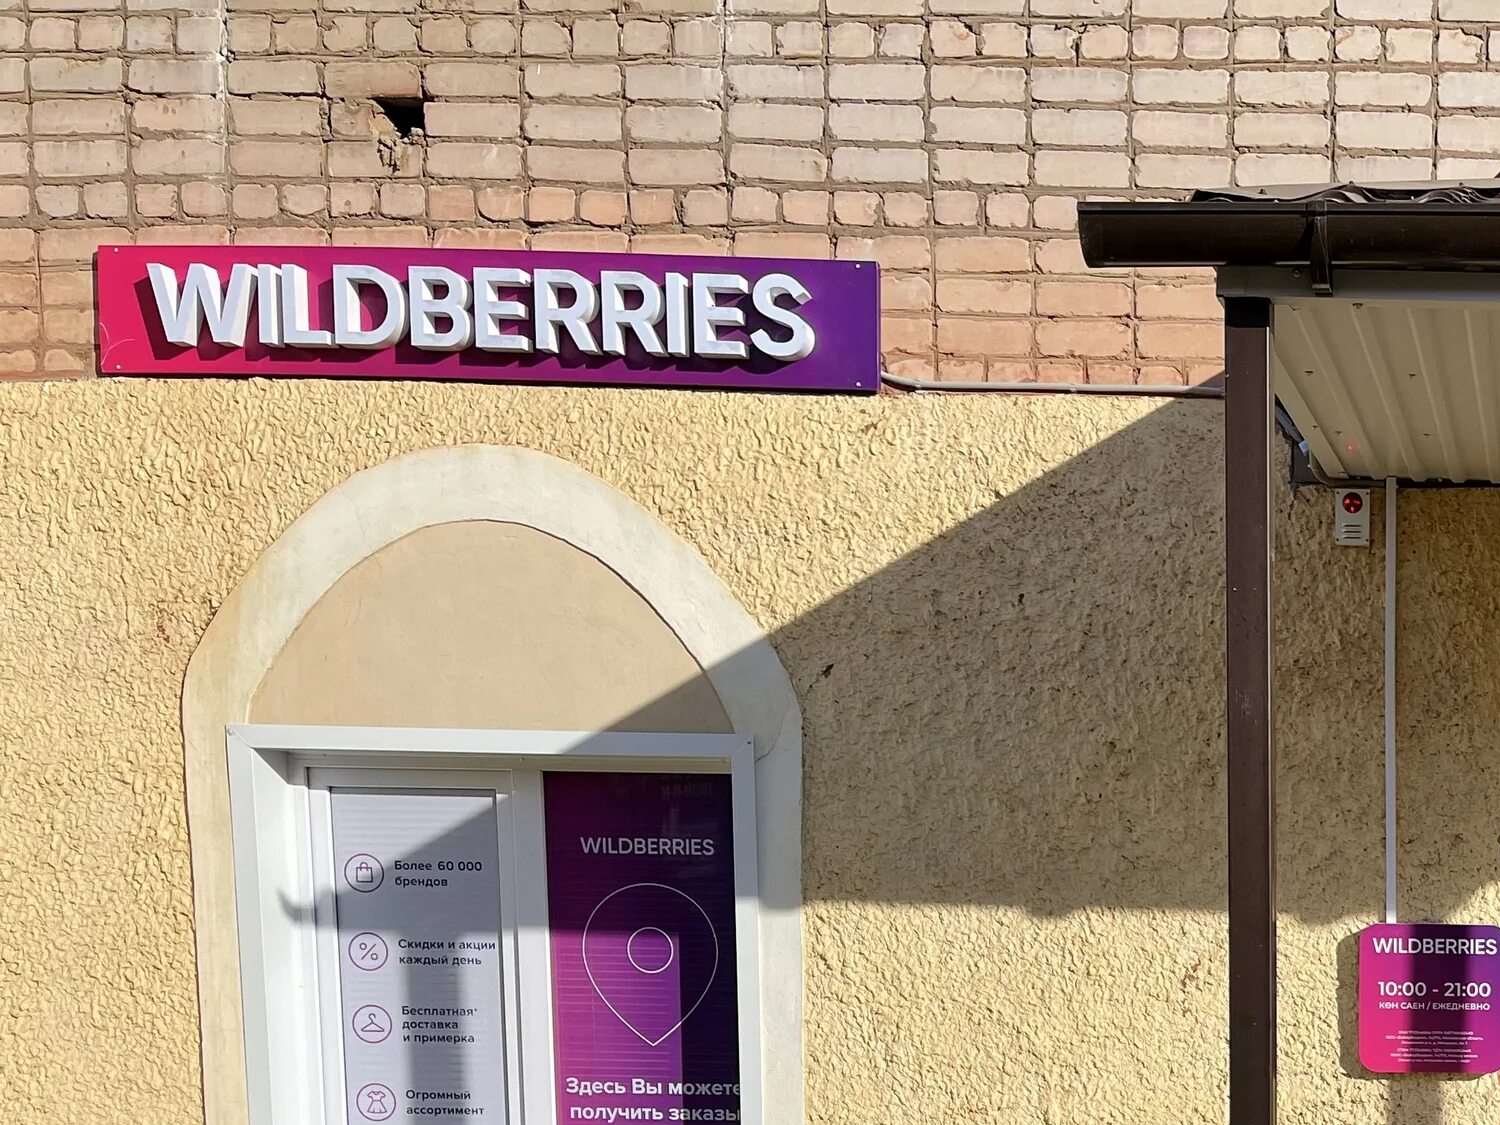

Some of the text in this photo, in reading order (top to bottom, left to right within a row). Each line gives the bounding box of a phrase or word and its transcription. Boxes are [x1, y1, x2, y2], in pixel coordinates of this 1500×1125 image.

[146, 262, 815, 361] WILDBERRIES
[580, 837, 715, 856] WILDBERRIES
[394, 860, 482, 872] Более 60 000
[394, 876, 448, 888] брендов
[398, 939, 496, 951] Скидки и акции
[1372, 937, 1498, 955] WILDBERRIES
[399, 955, 482, 966] каждый день
[1378, 981, 1427, 997] 10:00
[1444, 982, 1491, 998] 21:00
[1400, 1002, 1425, 1010] САЕН
[1432, 1002, 1491, 1011] ЕЖЕДНЕВНО
[402, 1021, 459, 1030] доставка
[403, 1034, 475, 1044] и примерка
[566, 1077, 740, 1096] Здесь Вы можете
[405, 1089, 471, 1101] Огромный
[406, 1107, 485, 1116] ассортимент
[570, 1106, 740, 1123] получить заказы
